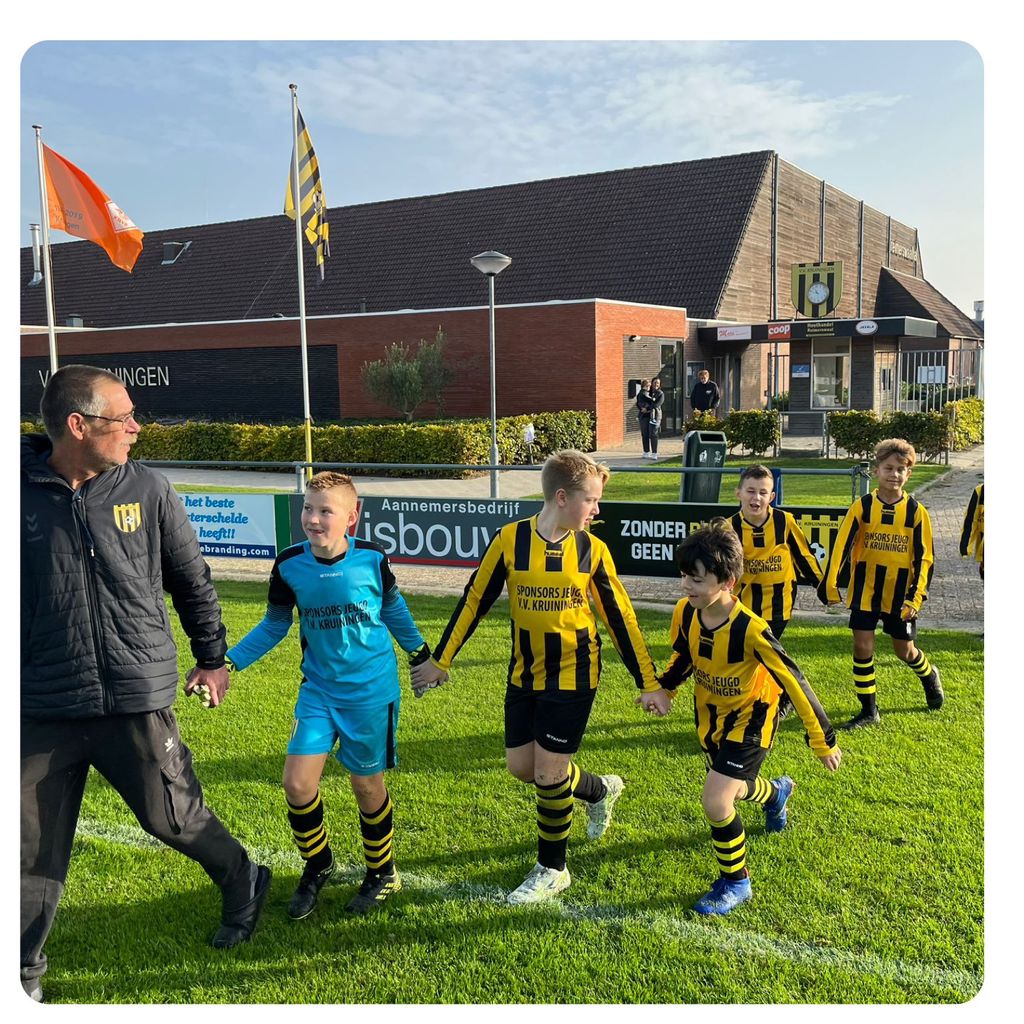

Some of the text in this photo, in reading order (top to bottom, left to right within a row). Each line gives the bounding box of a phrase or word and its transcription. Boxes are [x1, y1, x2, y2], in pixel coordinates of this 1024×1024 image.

[768, 324, 790, 334] coop
[185, 495, 234, 508] het beste
[381, 498, 519, 518] Aannemersbedrijf
[199, 527, 235, 540] heeft!!
[620, 520, 686, 538] ZONDER
[631, 543, 673, 560] GEEN
[517, 585, 583, 599] SPONSORS JEUG
[532, 598, 584, 611] KRUININGEN
[319, 613, 371, 630] KRUININGEN
[712, 676, 740, 688] JEUGD
